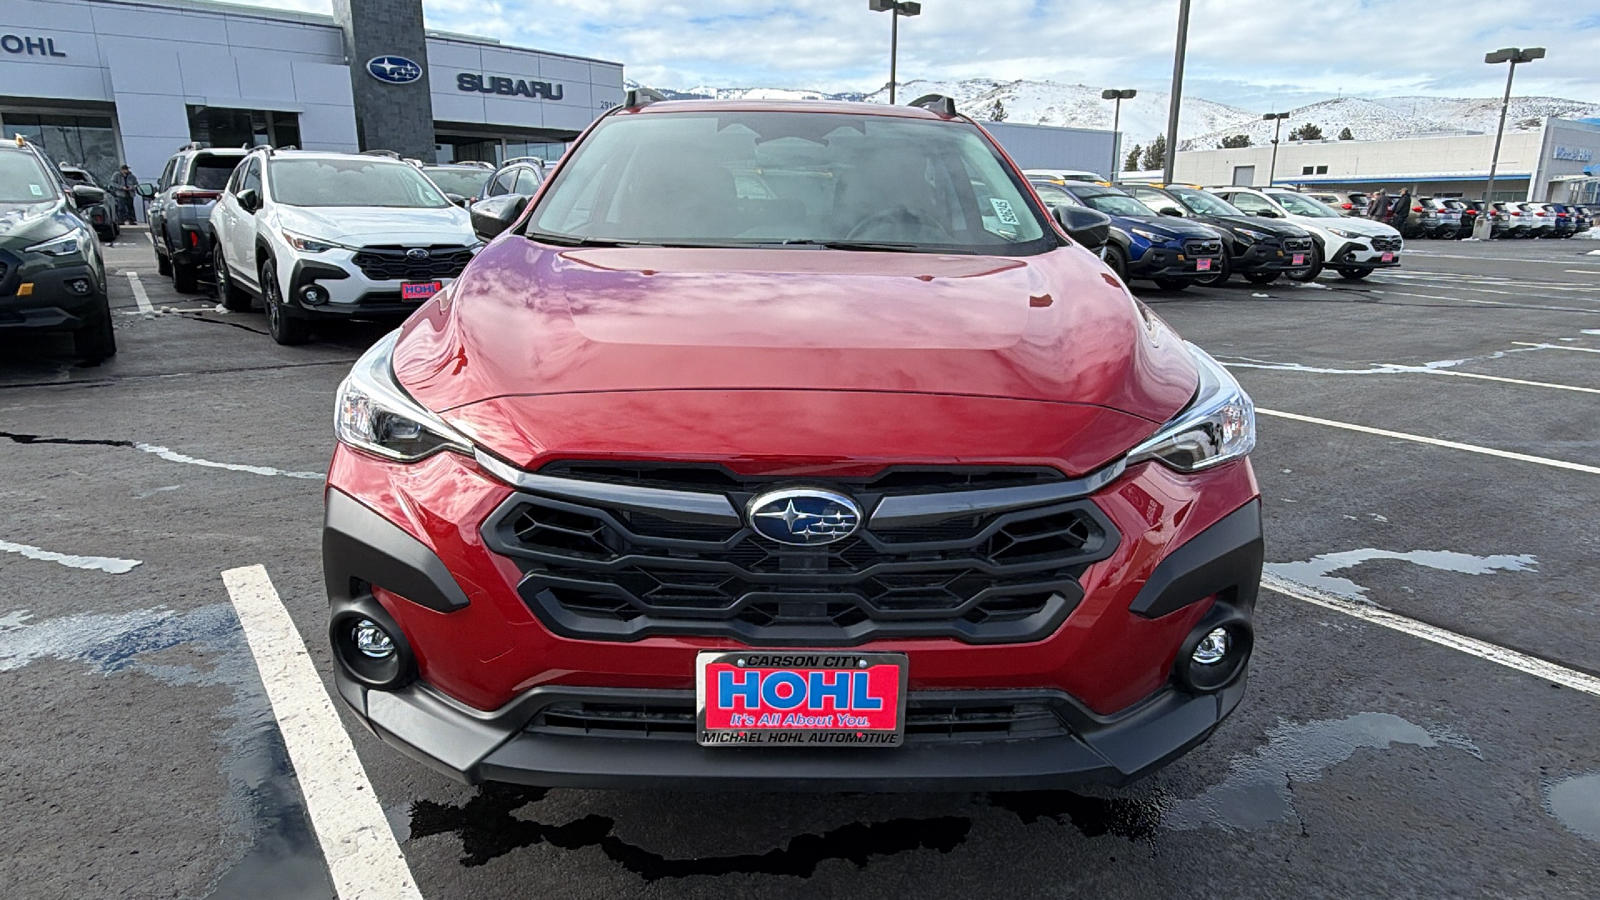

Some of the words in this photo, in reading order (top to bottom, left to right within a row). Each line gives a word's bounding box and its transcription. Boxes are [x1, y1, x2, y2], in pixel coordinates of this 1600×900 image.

[457, 73, 563, 100] SUBARU
[405, 285, 439, 293] HOHL
[747, 655, 819, 667] CARSON
[823, 656, 862, 667] CITY
[718, 670, 883, 710] HOHL
[730, 712, 755, 726] It's
[757, 712, 781, 726] All
[782, 712, 833, 727] About
[836, 713, 870, 727] You.
[702, 732, 764, 743] MICHAEL
[768, 732, 804, 743] HOHL
[808, 732, 898, 744] AUTOMOTIVE
